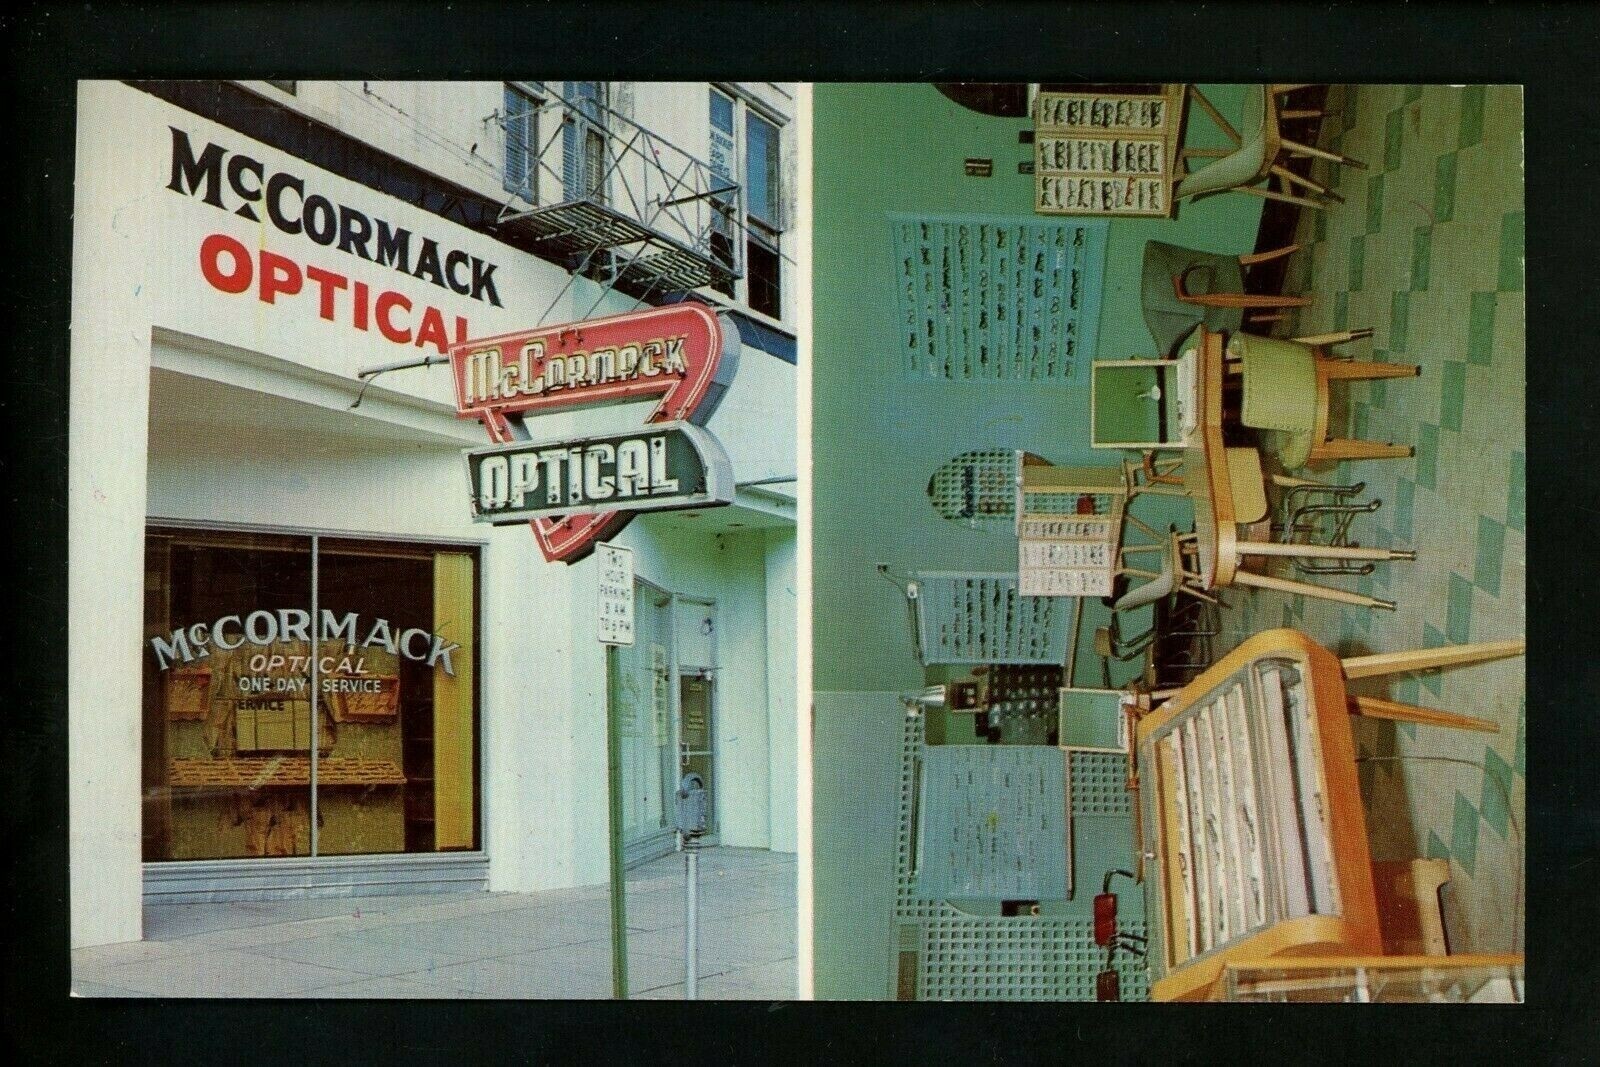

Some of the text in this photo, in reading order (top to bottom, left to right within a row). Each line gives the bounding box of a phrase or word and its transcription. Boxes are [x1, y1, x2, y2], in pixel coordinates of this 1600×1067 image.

[165, 125, 505, 309] McCORMACK
[479, 436, 679, 510] OPTICAL
[150, 608, 461, 677] McCORMACK
[249, 653, 370, 675] OPTICAL
[238, 677, 382, 694] ONE DAY SERVICE
